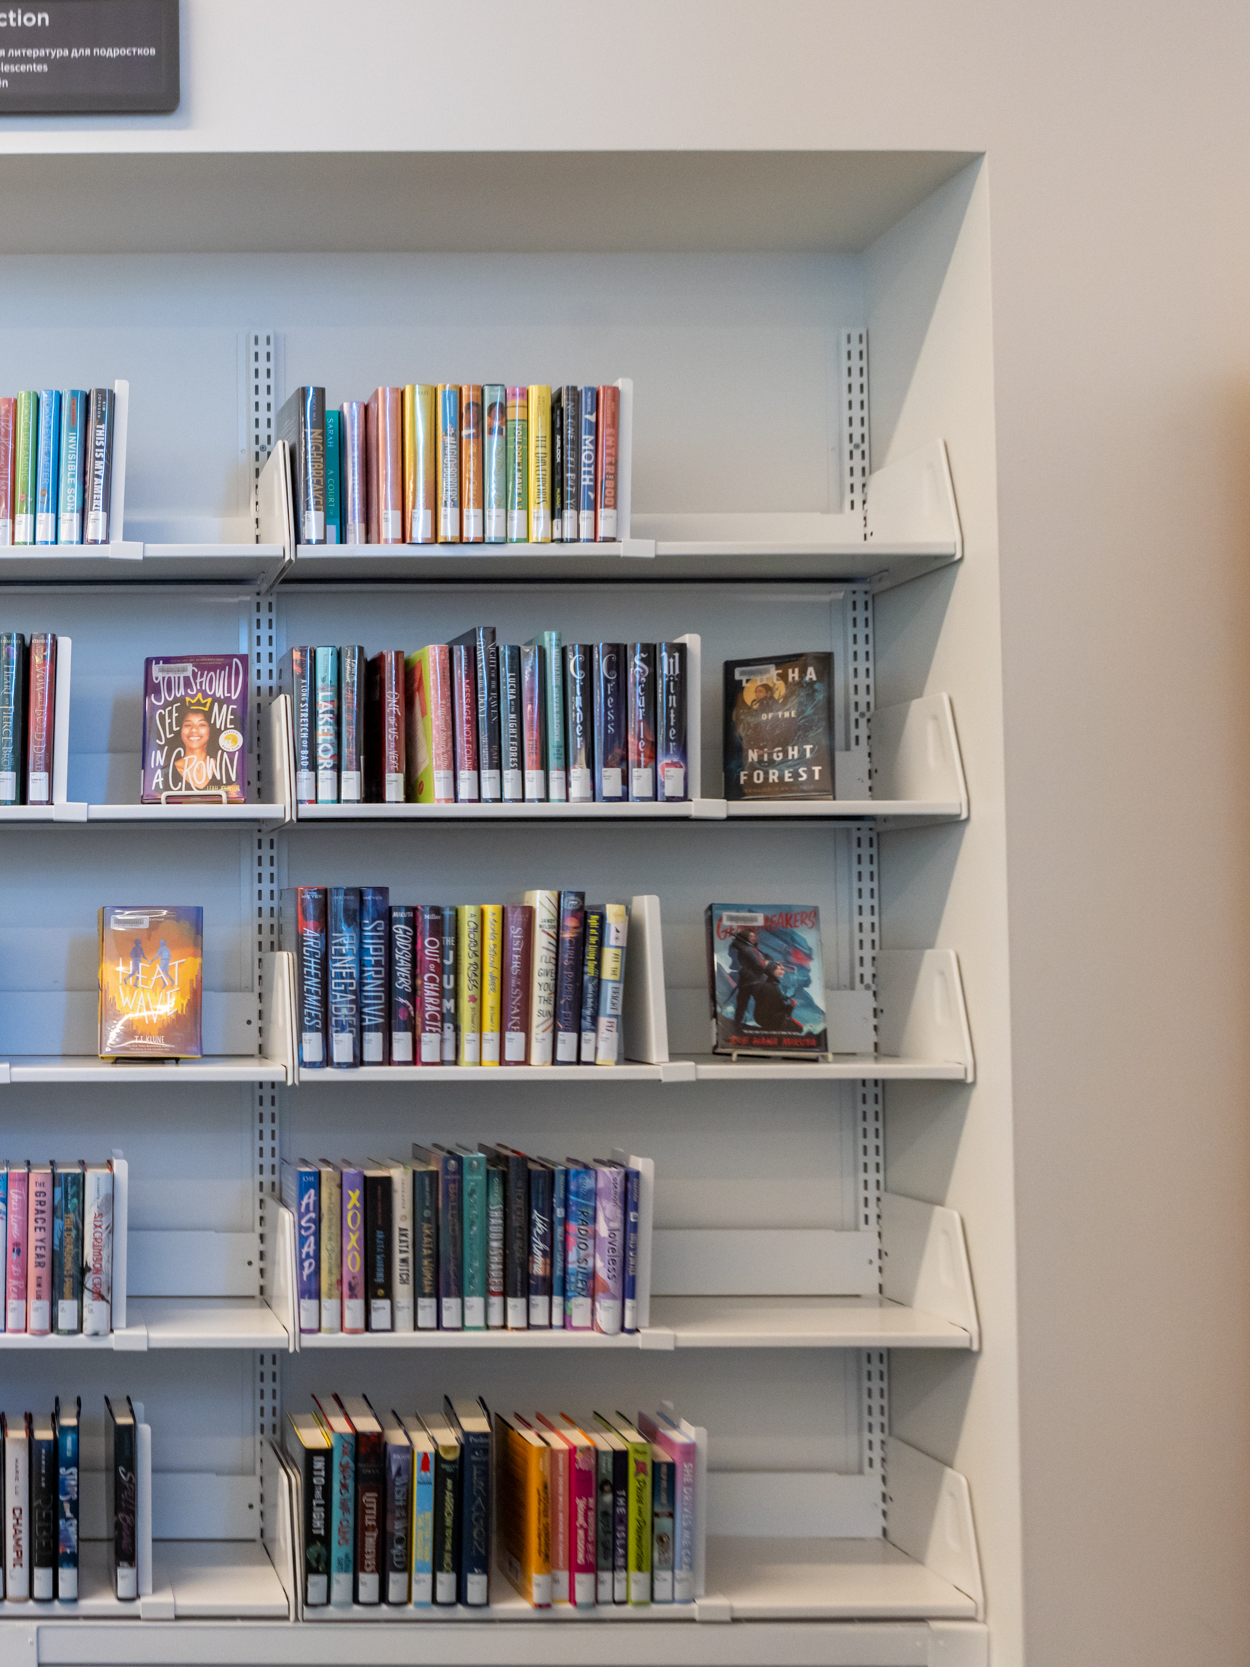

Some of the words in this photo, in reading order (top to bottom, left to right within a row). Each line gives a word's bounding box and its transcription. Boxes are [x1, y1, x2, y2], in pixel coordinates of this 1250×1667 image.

[8, 48, 68, 59] литература
[72, 48, 91, 58] для
[93, 46, 156, 57] подростков
[67, 432, 76, 484] INVISIBLE
[443, 436, 456, 464] MAGIC
[582, 435, 594, 485] MOTH
[67, 488, 76, 511] SON
[443, 469, 457, 501] BORDERS
[151, 660, 184, 705] You
[187, 658, 242, 700] SHOULD
[156, 702, 181, 745] SEE
[211, 702, 237, 730] ME
[778, 710, 796, 719] THE
[151, 746, 168, 768] IN
[748, 744, 814, 762] NIGHT
[152, 768, 163, 790] A
[169, 747, 238, 792] CROWN
[740, 766, 822, 784] FOREST
[442, 936, 455, 946] THE
[115, 957, 186, 989] HEAT
[361, 920, 385, 1025] SUPERNOVA
[392, 924, 414, 992] GODSLAYERS
[538, 968, 554, 977] GIVE
[302, 927, 324, 1028] ARCHENEMIES
[119, 985, 180, 1024] WAVE
[538, 995, 552, 1005] THE
[146, 1035, 165, 1044] KLUNE
[35, 1191, 46, 1232] GRACE
[92, 1213, 103, 1230] SIX
[532, 1210, 550, 1236] Like
[300, 1189, 316, 1281] ASAP
[347, 1189, 360, 1273] XOXO
[398, 1227, 409, 1254] AKATA
[577, 1210, 589, 1250] RADIO
[35, 1238, 46, 1268] YEAR
[92, 1230, 103, 1275] CRIMSON
[531, 1236, 549, 1275] home
[606, 1228, 620, 1281] loveless
[399, 1257, 410, 1285] WITCH
[313, 1456, 325, 1484] INTO
[312, 1499, 325, 1536] LIGHT
[362, 1492, 378, 1527] LITTLE
[616, 1490, 626, 1514] THE
[364, 1531, 378, 1573] THIEVES
